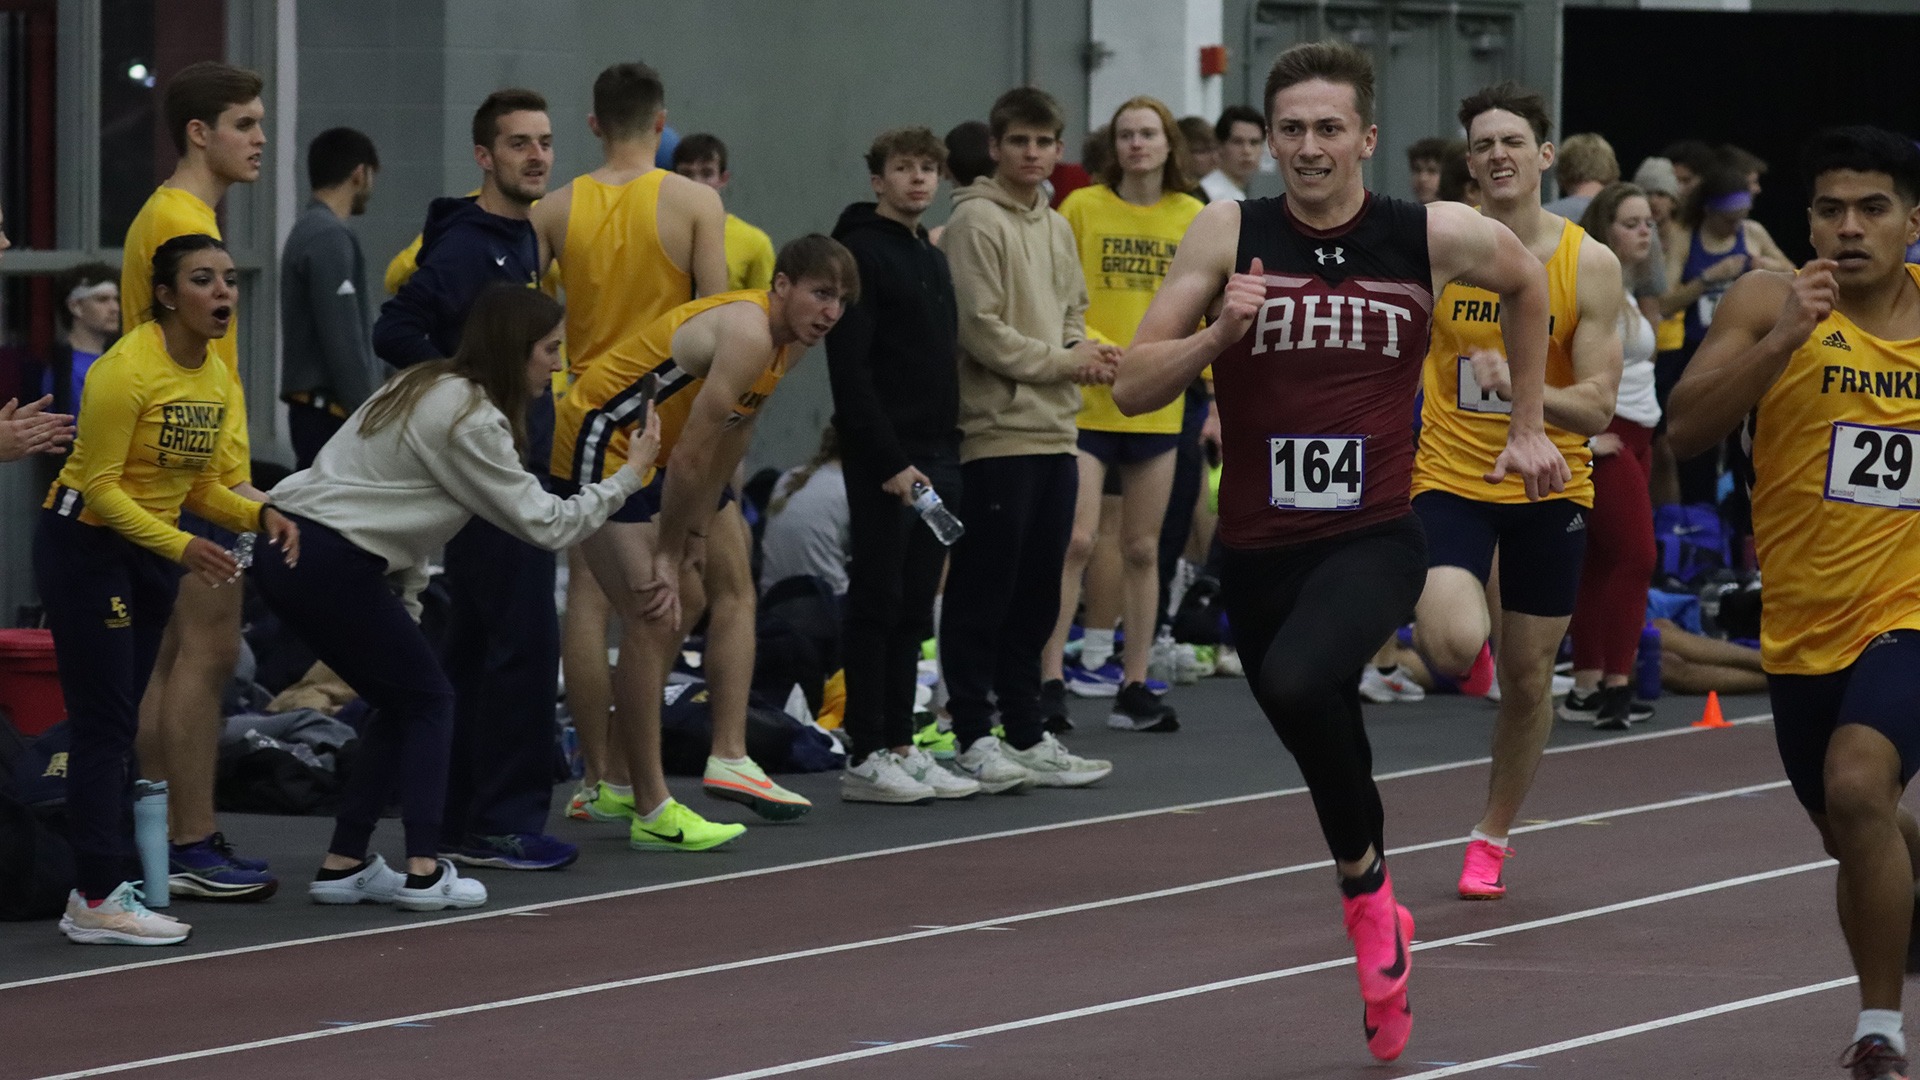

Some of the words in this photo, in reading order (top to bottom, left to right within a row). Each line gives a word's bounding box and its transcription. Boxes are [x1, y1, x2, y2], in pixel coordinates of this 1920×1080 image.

[1251, 295, 1412, 358] RHIT
[1821, 365, 1920, 399] FRANK
[1275, 440, 1361, 493] 164
[1848, 430, 1913, 491] 29
